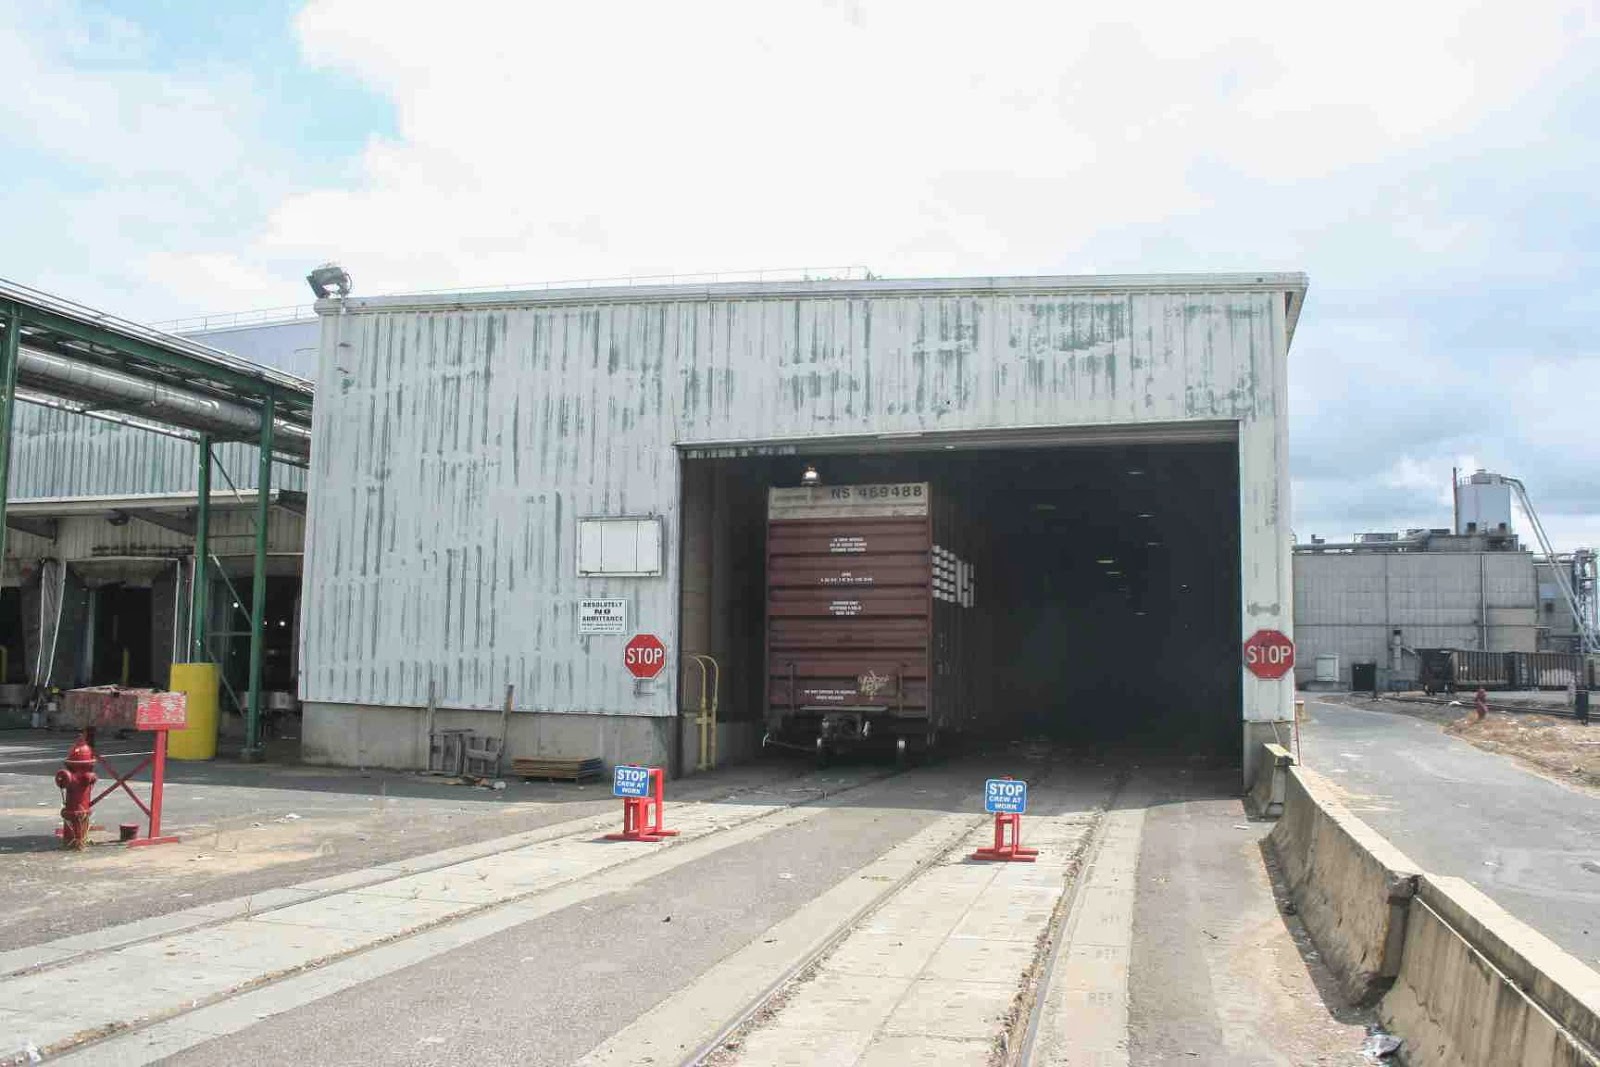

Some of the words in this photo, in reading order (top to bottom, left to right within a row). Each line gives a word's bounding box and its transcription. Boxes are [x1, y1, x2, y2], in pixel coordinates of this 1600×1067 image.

[831, 487, 850, 499] NS
[626, 647, 663, 665] STOP
[1246, 645, 1291, 664] STOP
[617, 769, 647, 783] STOP
[616, 780, 636, 788] CREW
[988, 783, 1024, 796] STOP
[621, 787, 642, 795] WORK
[988, 795, 1011, 803] CREW
[994, 803, 1018, 811] WORK
